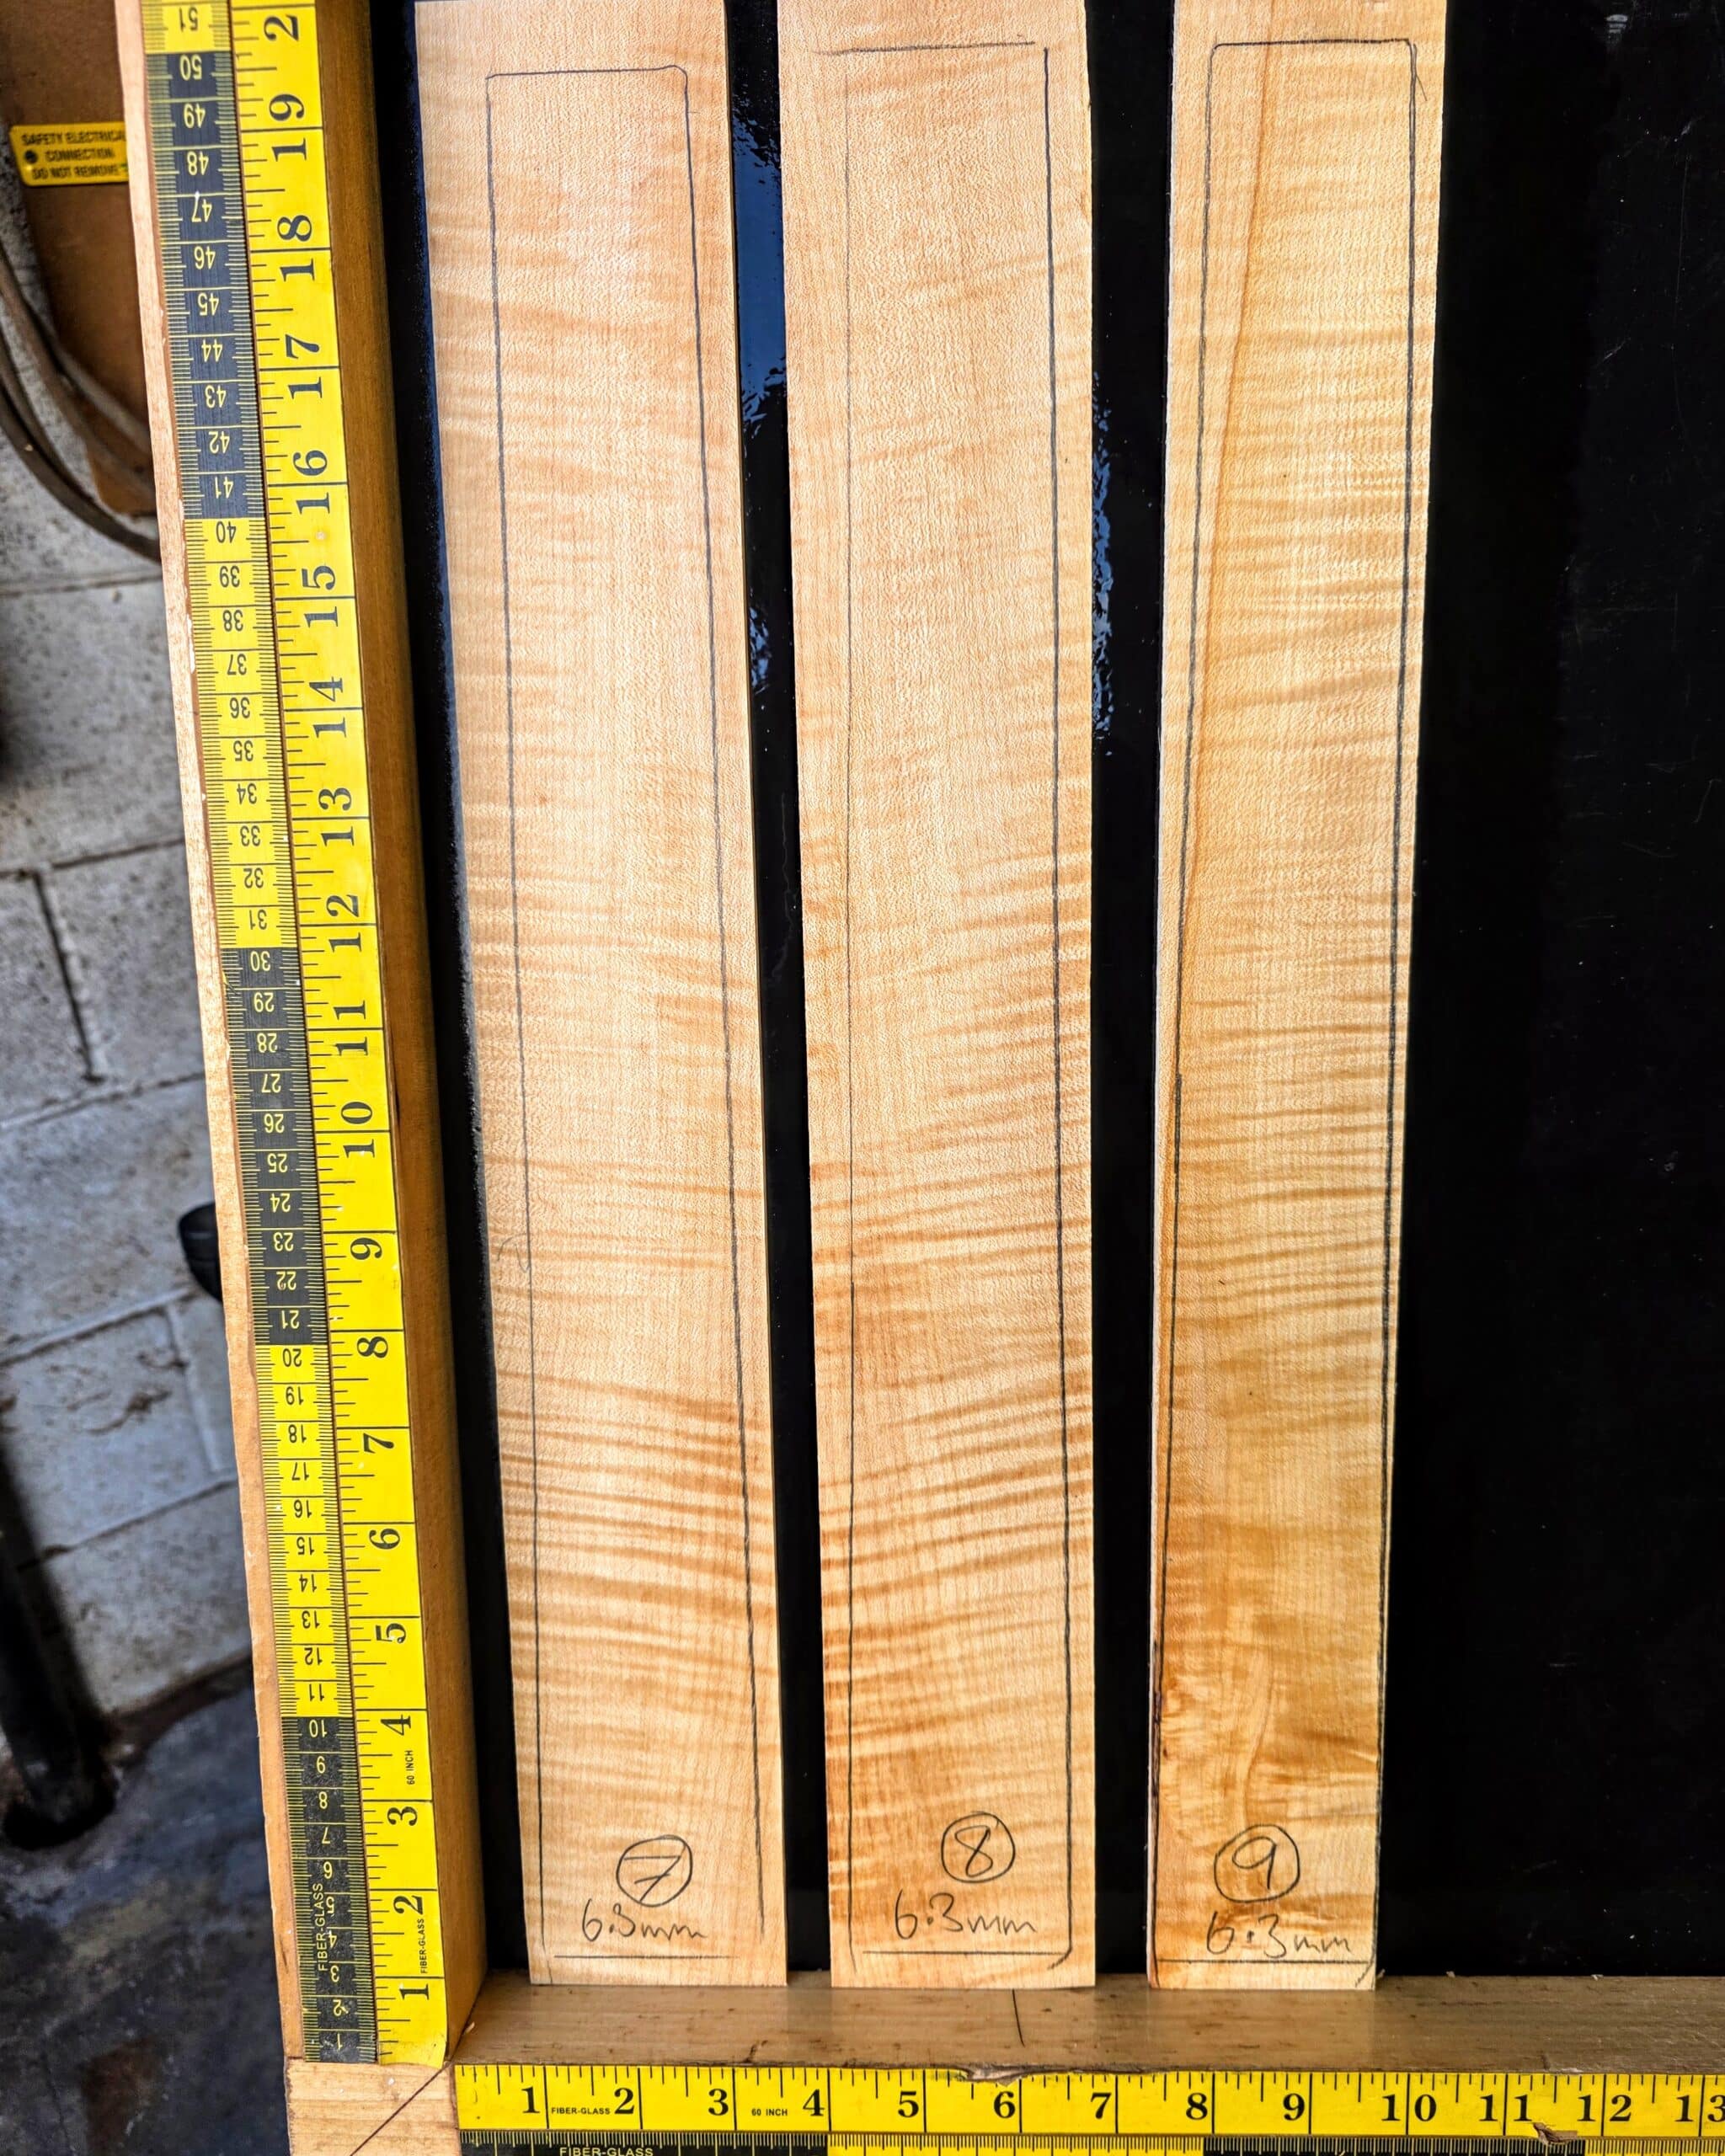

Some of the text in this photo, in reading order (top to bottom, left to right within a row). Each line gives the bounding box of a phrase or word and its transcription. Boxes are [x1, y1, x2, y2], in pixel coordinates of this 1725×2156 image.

[179, 7, 199, 32] 51
[179, 55, 203, 81] 50
[183, 103, 206, 128] 49
[21, 130, 126, 146] SAFETY ELECTRICA
[45, 148, 115, 162] CONNECTION
[186, 151, 209, 176] 48
[32, 164, 119, 179] DO NOT REMOVE
[191, 198, 212, 223] 47
[194, 246, 216, 270] 46
[197, 292, 220, 316] 45
[201, 339, 223, 362] 44
[204, 385, 227, 408] 43
[208, 431, 231, 454] 42
[215, 476, 234, 499] 41
[216, 521, 237, 544] 40
[219, 565, 241, 588] 39
[222, 609, 244, 632] 38
[227, 653, 248, 675] 37
[229, 697, 251, 719] 36
[232, 740, 254, 762] 35
[236, 783, 258, 805] 34
[239, 825, 261, 846] 33
[243, 867, 264, 889] 32
[248, 909, 268, 931] 31
[250, 950, 271, 972] 30
[254, 991, 275, 1013] 29
[256, 1033, 278, 1054] 28
[260, 1073, 282, 1093] 27
[264, 1113, 285, 1134] 26
[267, 1153, 288, 1173] 25
[270, 1193, 291, 1213] 24
[273, 1231, 294, 1252] 23
[350, 1237, 382, 1261] 9
[275, 1271, 297, 1291] 22
[281, 1310, 300, 1330] 21
[282, 1348, 302, 1368] 20
[356, 1336, 389, 1358] 8
[286, 1386, 304, 1406] 19
[288, 1424, 307, 1444] 18
[363, 1433, 395, 1454] 7
[291, 1462, 310, 1481] 17
[293, 1499, 312, 1519] 16
[296, 1536, 315, 1556] 15
[369, 1528, 401, 1550] 6
[299, 1574, 318, 1593] 14
[302, 1610, 320, 1630] 13
[376, 1623, 407, 1644] 5
[304, 1647, 323, 1666] 12
[308, 1684, 325, 1702] 11
[308, 1719, 328, 1738] 10
[380, 1715, 411, 1737] 4
[316, 1756, 326, 1774] 9
[404, 1750, 415, 1785] 60 INCH
[318, 1791, 328, 1810] 8
[387, 1806, 418, 1827] 3
[321, 1827, 331, 1844] 7
[954, 1825, 994, 1877] 8
[323, 1861, 333, 1879] 6
[1232, 1836, 1277, 1890] 9
[623, 1855, 681, 1902] 7
[326, 1896, 335, 1915] 5
[393, 1895, 424, 1915] 2
[312, 1883, 328, 1972] FIBER-GLASS
[328, 1929, 337, 1950] 4
[417, 1918, 428, 1974] FIBER-GLASS
[331, 1966, 340, 1983] 3
[399, 1983, 430, 2000] 1
[333, 1999, 343, 2017] 2
[337, 2033, 343, 2050] 1
[521, 2087, 541, 2114] 1
[551, 2106, 611, 2116] FIBER-GLASS
[613, 2088, 636, 2116] 2
[708, 2088, 730, 2116] 3
[802, 2089, 825, 2117] 4
[898, 2091, 920, 2118] 5
[993, 2090, 1017, 2119] 6
[1091, 2092, 1112, 2120] 7
[1186, 2092, 1209, 2121] 8
[1283, 2093, 1306, 2121] 9
[751, 2108, 788, 2117] 60 INCH
[559, 2147, 654, 2156] FIBER-GLASS
